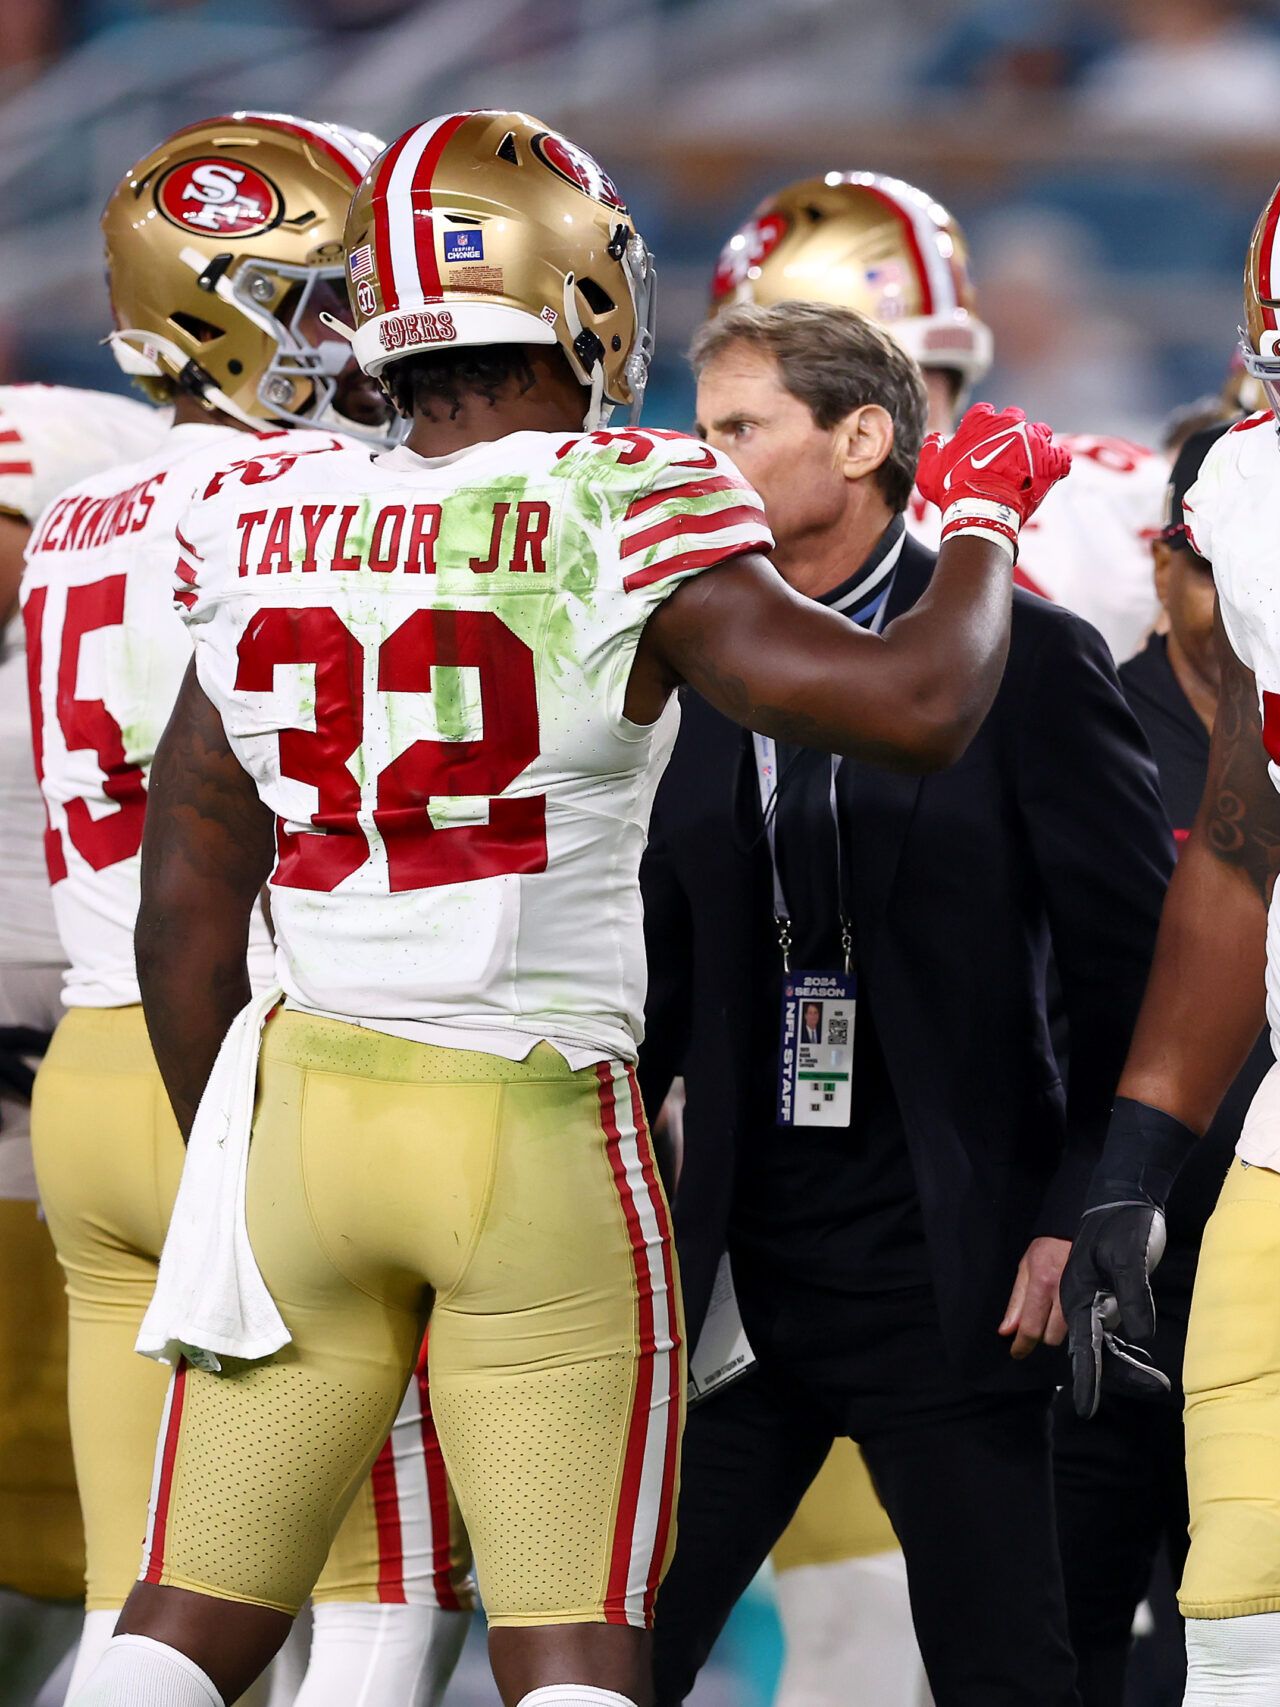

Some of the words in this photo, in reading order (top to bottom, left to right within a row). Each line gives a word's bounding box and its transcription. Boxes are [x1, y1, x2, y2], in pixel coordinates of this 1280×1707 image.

[447, 251, 481, 260] CHANGE
[359, 286, 375, 313] 37
[541, 307, 556, 323] 32
[379, 311, 457, 351] 49ERS
[236, 503, 443, 578] TAYLOR
[468, 501, 551, 573] JR
[22, 573, 148, 886] 15
[234, 606, 548, 892] 32
[794, 986, 846, 998] SEASON
[803, 976, 837, 987] 2024
[785, 1002, 796, 1045] NFL
[781, 1049, 794, 1122] STAFF
